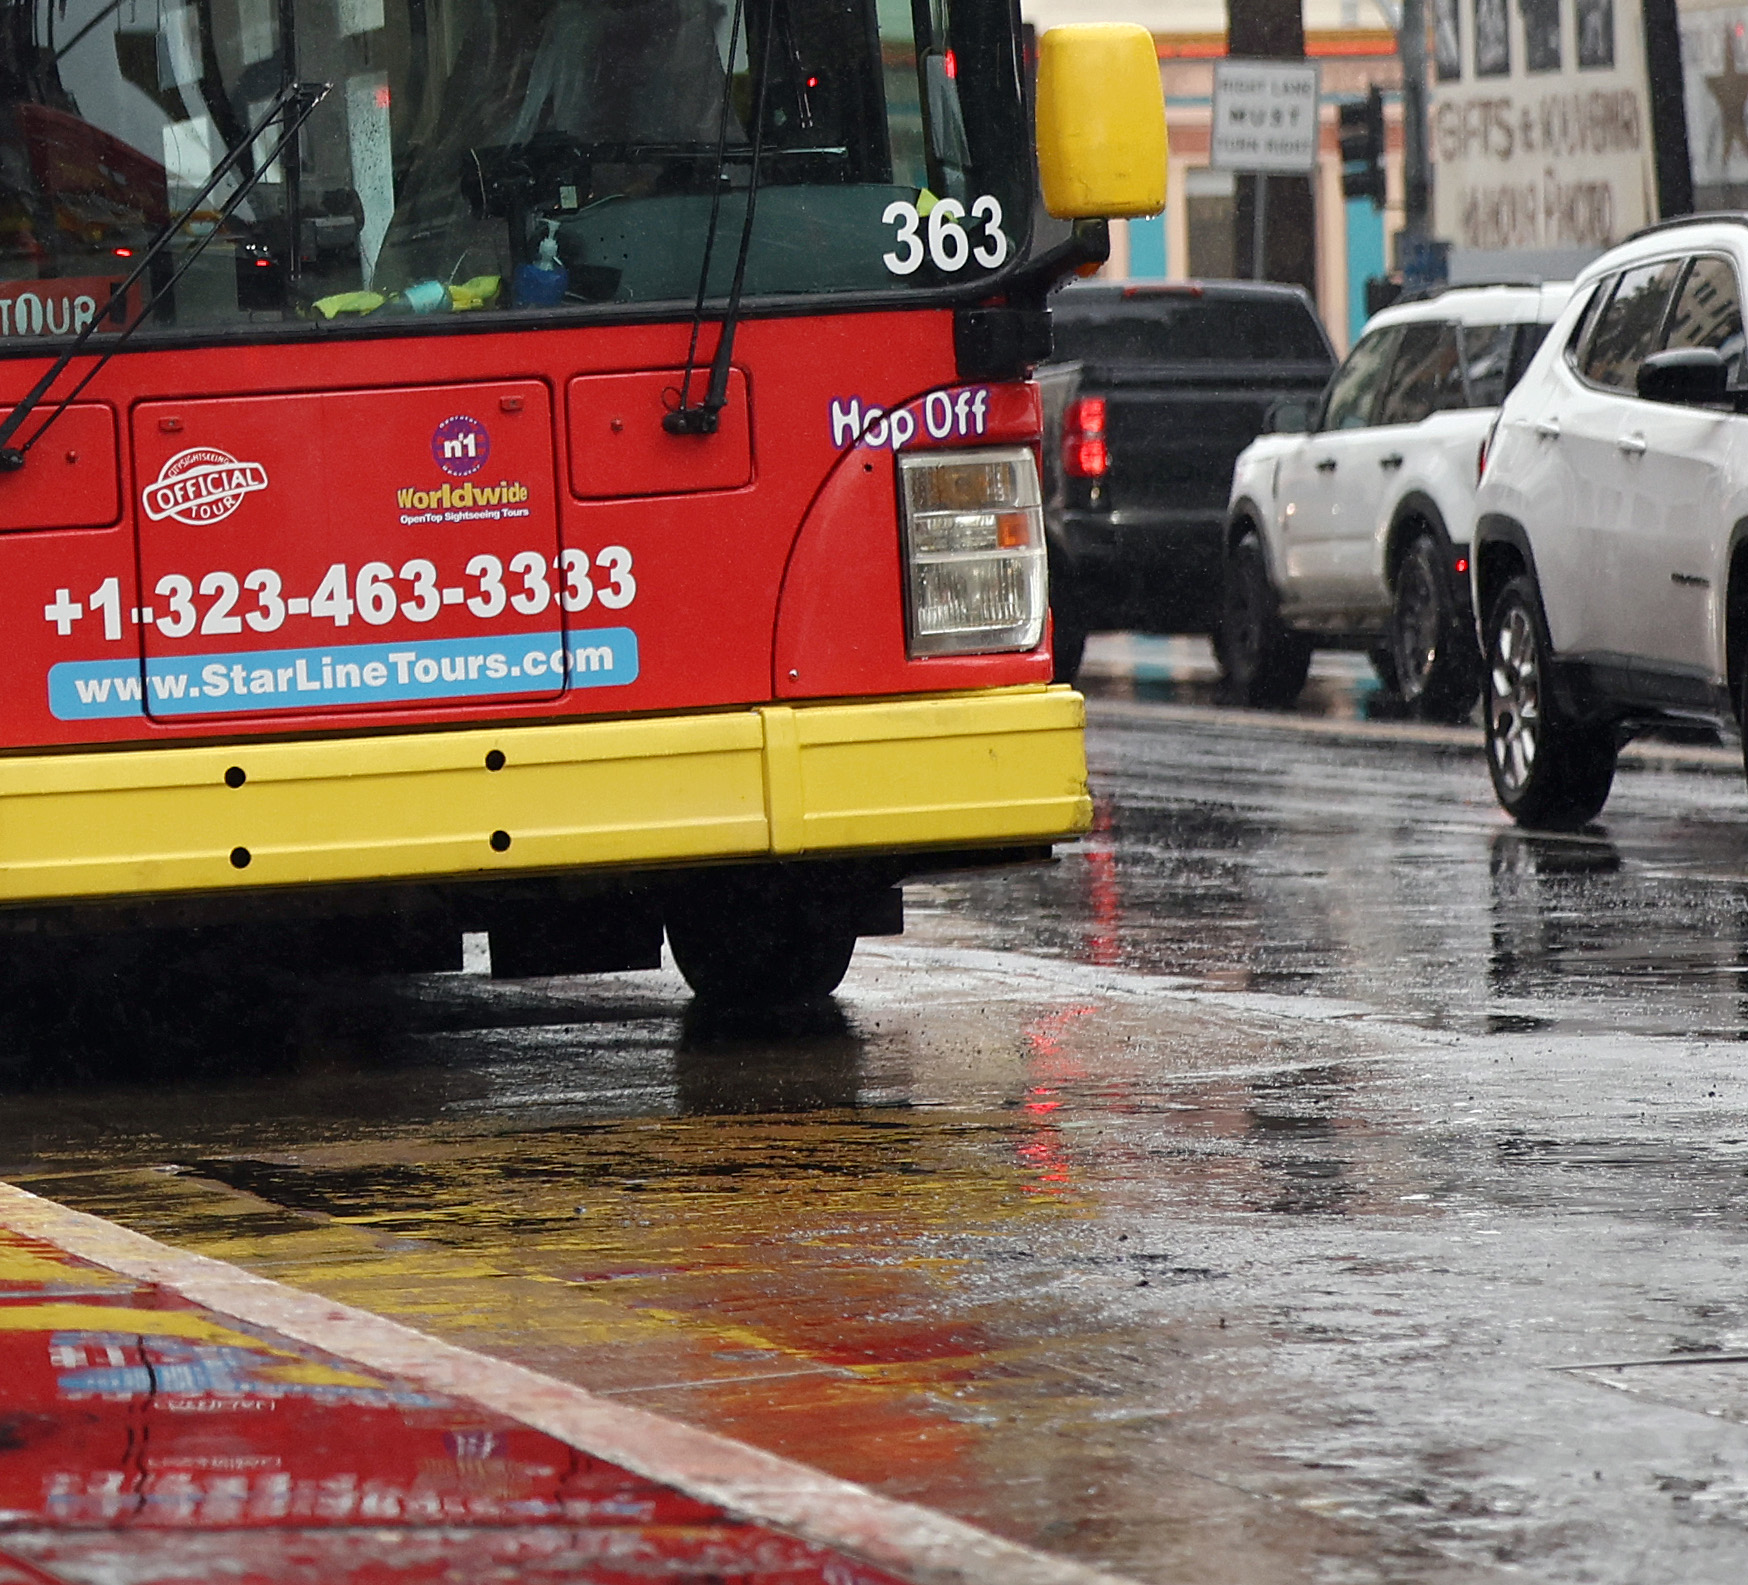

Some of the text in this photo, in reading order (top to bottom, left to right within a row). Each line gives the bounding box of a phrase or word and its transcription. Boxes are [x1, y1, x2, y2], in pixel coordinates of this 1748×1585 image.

[881, 195, 1008, 274] 363
[831, 389, 988, 450] Hop Off
[156, 468, 260, 510] OFFICIAL
[191, 496, 237, 519] TOUR
[397, 480, 529, 510] Worldwide
[399, 508, 530, 526] OpenTop Sightseeing Tours
[44, 545, 637, 641] +1-323-463-3333
[75, 644, 615, 705] www.StarLineTours.com
